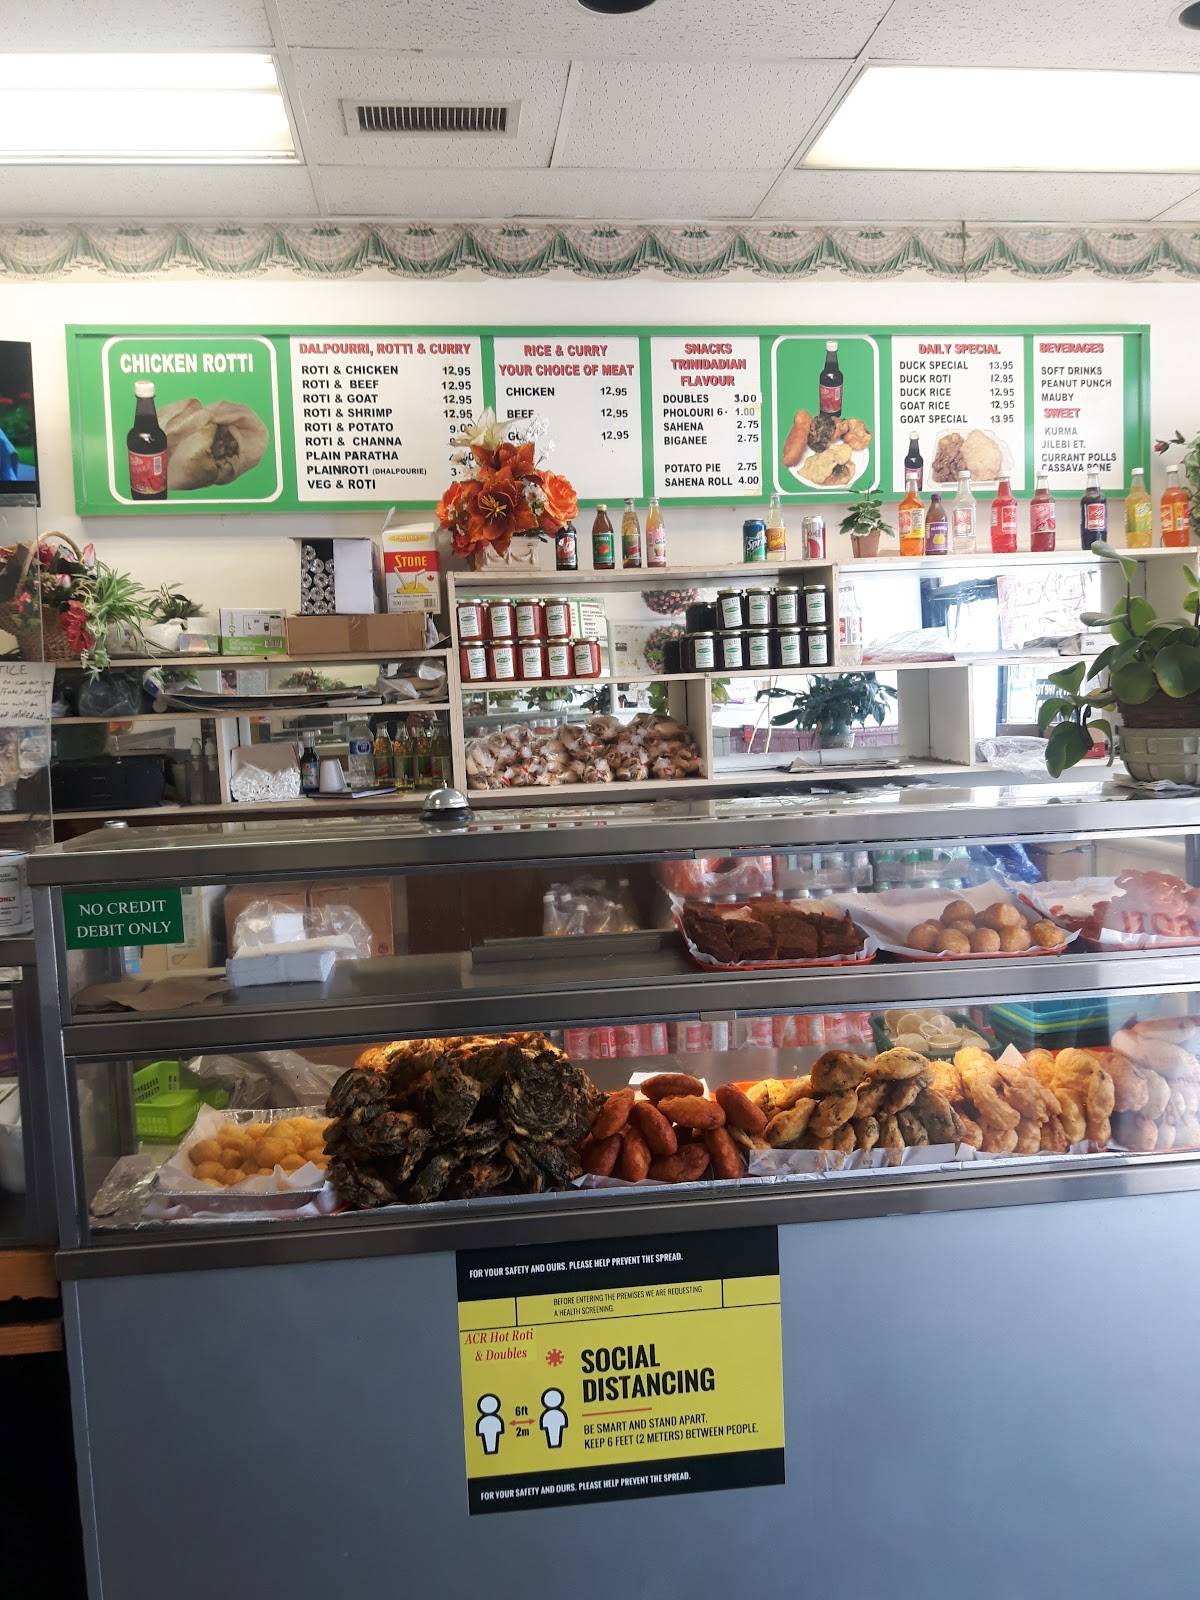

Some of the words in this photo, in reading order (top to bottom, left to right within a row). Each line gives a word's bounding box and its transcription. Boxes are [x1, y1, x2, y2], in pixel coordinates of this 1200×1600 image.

[299, 343, 374, 356] DALPOURRI,
[376, 343, 414, 355] ROTTI
[416, 343, 427, 355] &
[429, 343, 471, 355] CURRY
[523, 345, 552, 356] RICE
[555, 345, 564, 356] &
[567, 345, 608, 356] CURRY
[684, 343, 733, 354] SNACKS
[918, 344, 952, 354] DAILY
[955, 344, 1002, 354] SPECIAL
[1039, 343, 1104, 353] BEVERAGES
[120, 353, 198, 373] CHICKEN
[202, 353, 254, 372] ROTTI
[670, 359, 746, 370] TRINIDADIAN
[899, 361, 926, 370] DUCK
[929, 361, 969, 370] SPECIAL
[989, 361, 1014, 370] 13.95
[301, 365, 329, 375] ROTI
[333, 365, 342, 375] &
[345, 365, 399, 375] CHICKEN
[442, 366, 471, 376] 12.95
[499, 364, 533, 376] YOUR
[535, 364, 580, 376] CHOICE
[583, 364, 599, 376] OF
[602, 364, 635, 376] MEAT
[1041, 366, 1065, 375] SOFT
[1067, 366, 1102, 375] DRINKS
[680, 375, 735, 386] FLAVOUR
[900, 374, 926, 383] DUCK
[929, 374, 951, 383] ROTI
[990, 374, 1014, 383] 12.95
[1041, 379, 1078, 388] PEANUT
[1080, 379, 1112, 387] PUNCH
[302, 380, 330, 389] ROTI
[334, 380, 342, 389] &
[350, 380, 379, 389] BEEF
[441, 381, 472, 391] 12.95
[506, 387, 555, 396] CHICKEN
[600, 386, 628, 397] 12.95
[900, 388, 926, 397] DUCK
[929, 388, 951, 397] RICE
[989, 388, 1015, 396] 12.95
[303, 394, 331, 404] ROTI
[335, 394, 343, 404] &
[347, 394, 378, 404] GOAT
[442, 395, 472, 405] 12.95
[663, 394, 709, 403] DOUBLES
[1041, 393, 1074, 402] MAUBY
[900, 401, 926, 410] GOAT
[928, 401, 950, 410] RICE
[990, 400, 1015, 409] 12.95
[303, 408, 331, 418] ROTI
[335, 408, 344, 418] &
[347, 408, 393, 418] SHRIMP
[443, 409, 473, 419] 12.95
[507, 409, 535, 419] BEEF
[600, 408, 629, 418] 12.95
[663, 408, 714, 417] PHOLOURI
[736, 408, 755, 416] 1.00
[1043, 407, 1081, 418] SWEET
[900, 415, 926, 423] GOAT
[928, 415, 968, 423] SPECIAL
[990, 414, 1014, 423] 13.95
[304, 422, 332, 432] ROTI
[336, 422, 345, 432] &
[349, 422, 394, 432] POTATO
[663, 422, 704, 431] SAHENA
[736, 420, 759, 429] 2.75
[1044, 427, 1078, 435] KURMA
[601, 431, 629, 440] 12.95
[664, 436, 707, 445] BIGANEE
[737, 434, 759, 443] 2.75
[305, 437, 333, 447] ROTI
[337, 437, 345, 447] &
[352, 437, 402, 447] CHANNA
[1041, 440, 1070, 448] JILEBI
[306, 451, 341, 461] PLAIN
[345, 451, 399, 461] PARATHA
[1041, 453, 1085, 461] CURRANT
[306, 465, 369, 475] PLAINROTI
[664, 464, 702, 473] POTATO
[705, 463, 721, 472] PIE
[737, 462, 757, 471] 2.75
[1041, 463, 1085, 472] CASSAVA
[307, 480, 332, 490] VEG
[335, 480, 344, 490] &
[348, 479, 376, 490] ROTI
[665, 477, 705, 487] SAHENA
[708, 477, 733, 486] ROLL
[738, 476, 759, 485] 4.00
[80, 903, 103, 916] NO
[107, 900, 167, 914] CREDIT
[77, 923, 124, 938] DEBIT
[128, 921, 171, 935] ONLY
[469, 1269, 483, 1278] FOR
[484, 1267, 504, 1277] YOUR
[504, 1265, 530, 1276] SAFETY
[530, 1263, 545, 1273] AND
[546, 1262, 568, 1272] OURS.
[569, 1260, 593, 1270] PLEASE
[594, 1258, 611, 1268] HELP
[611, 1256, 641, 1266] PREVENT
[641, 1254, 654, 1264] THE
[655, 1252, 683, 1262] SPREAD.
[553, 1297, 574, 1305] BEFORE
[576, 1294, 604, 1304] ENTERING
[605, 1293, 615, 1301] THE
[616, 1290, 644, 1300] PREMISES
[645, 1289, 655, 1297] WE
[656, 1288, 667, 1296] ARE
[667, 1285, 703, 1295] REQUESTING
[559, 1307, 581, 1316] HEALTH
[464, 1332, 487, 1345] ACR
[490, 1331, 509, 1343] Hot
[512, 1328, 534, 1341] Roti
[475, 1351, 482, 1361] &
[486, 1347, 528, 1361] Doubles
[581, 1344, 661, 1374] SOCIAL
[582, 1367, 715, 1403] DISTANCING
[515, 1405, 528, 1416] 6ft
[584, 1424, 595, 1435] BE
[597, 1421, 626, 1434] SMART
[629, 1419, 647, 1431] AND
[648, 1416, 677, 1429] STAND
[679, 1413, 708, 1426] APART.
[516, 1427, 530, 1437] 2m
[584, 1437, 605, 1449] KEEP
[607, 1437, 613, 1447] 6
[615, 1434, 633, 1446] FEET
[636, 1434, 645, 1444] (2
[647, 1430, 683, 1443] METERS)
[685, 1426, 724, 1440] BETWEEN
[726, 1423, 759, 1436] PEOPLE.
[480, 1491, 494, 1501] FOR
[495, 1489, 514, 1499] YOUR
[515, 1486, 540, 1497] SAFETY
[540, 1485, 555, 1495] AND
[556, 1483, 577, 1493] OURS.
[578, 1481, 602, 1491] PLEASE
[603, 1479, 619, 1488] HELP
[620, 1476, 649, 1486] PREVENT
[650, 1474, 662, 1484] THE
[663, 1471, 691, 1482] SPREAD.
